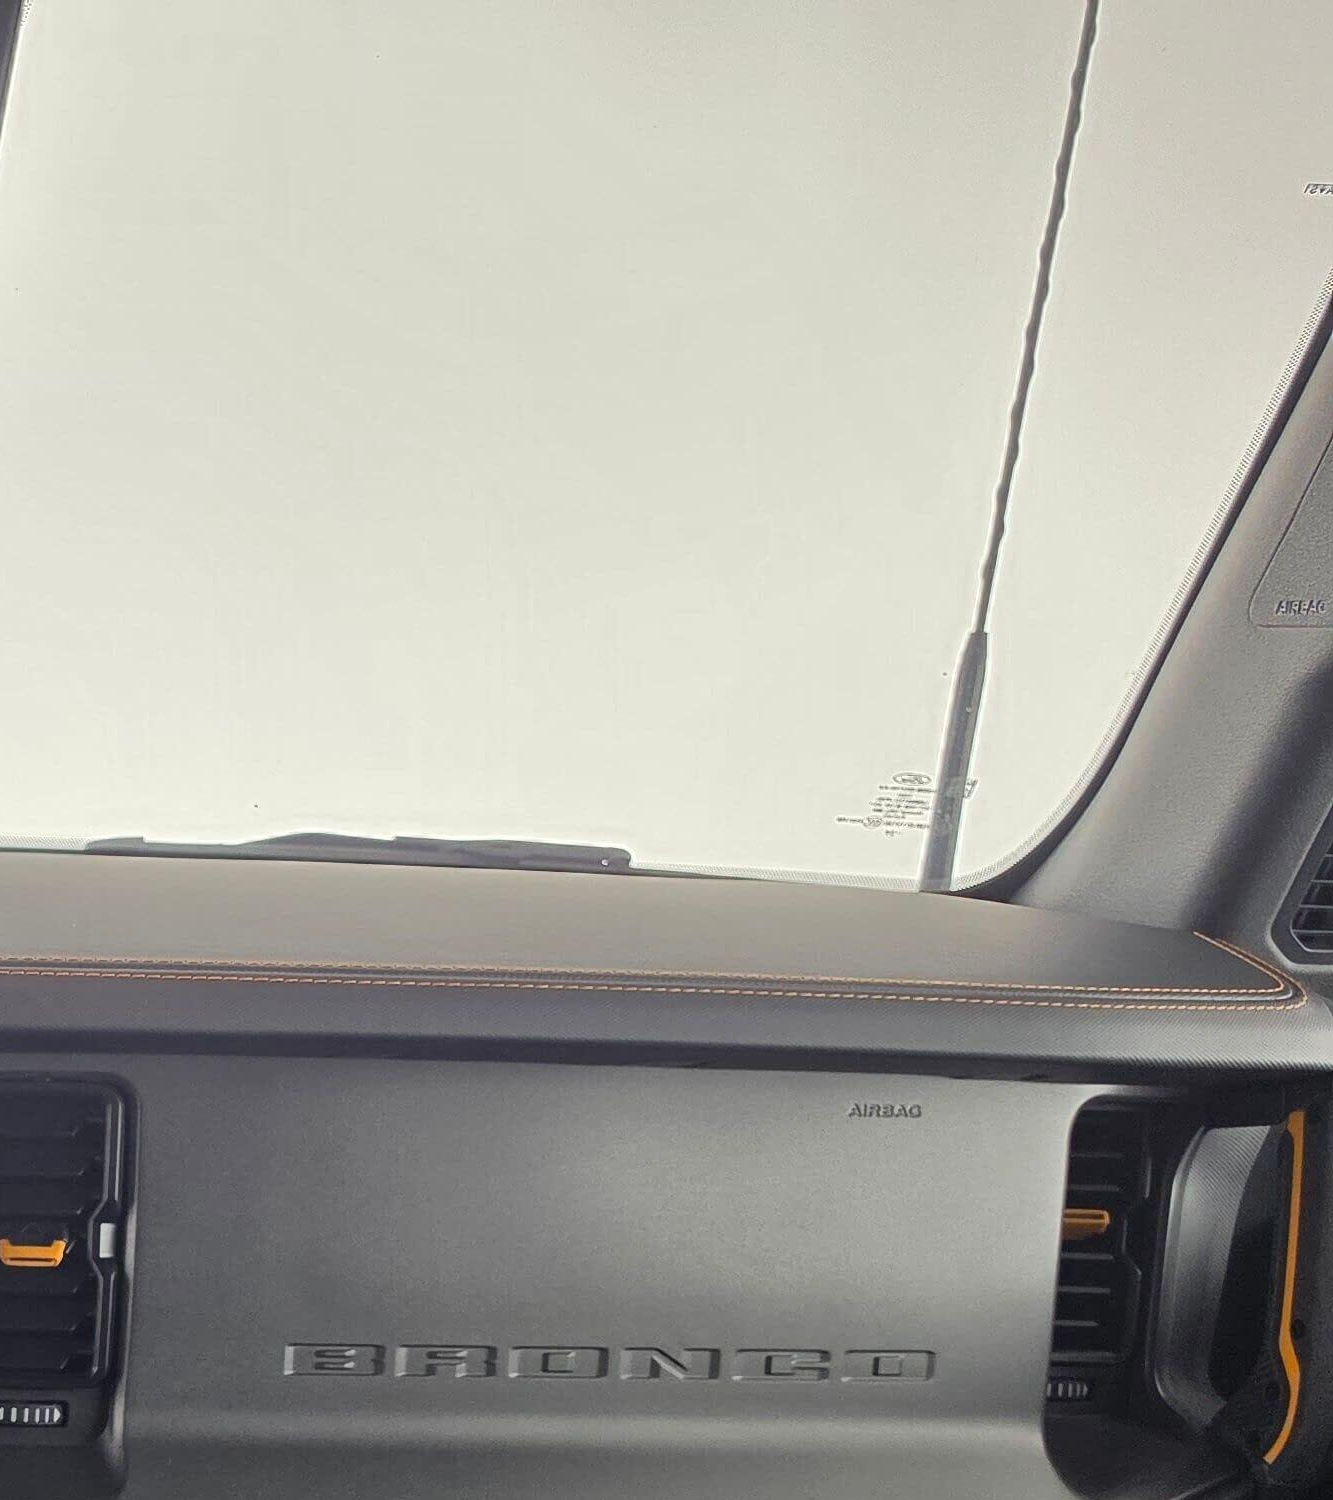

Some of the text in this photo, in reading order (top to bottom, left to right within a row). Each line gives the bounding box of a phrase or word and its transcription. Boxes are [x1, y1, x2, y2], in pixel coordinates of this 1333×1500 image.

[1275, 599, 1326, 616] AIRBAG
[848, 1103, 922, 1118] AIRBAG
[284, 1343, 936, 1382] BRONCO
